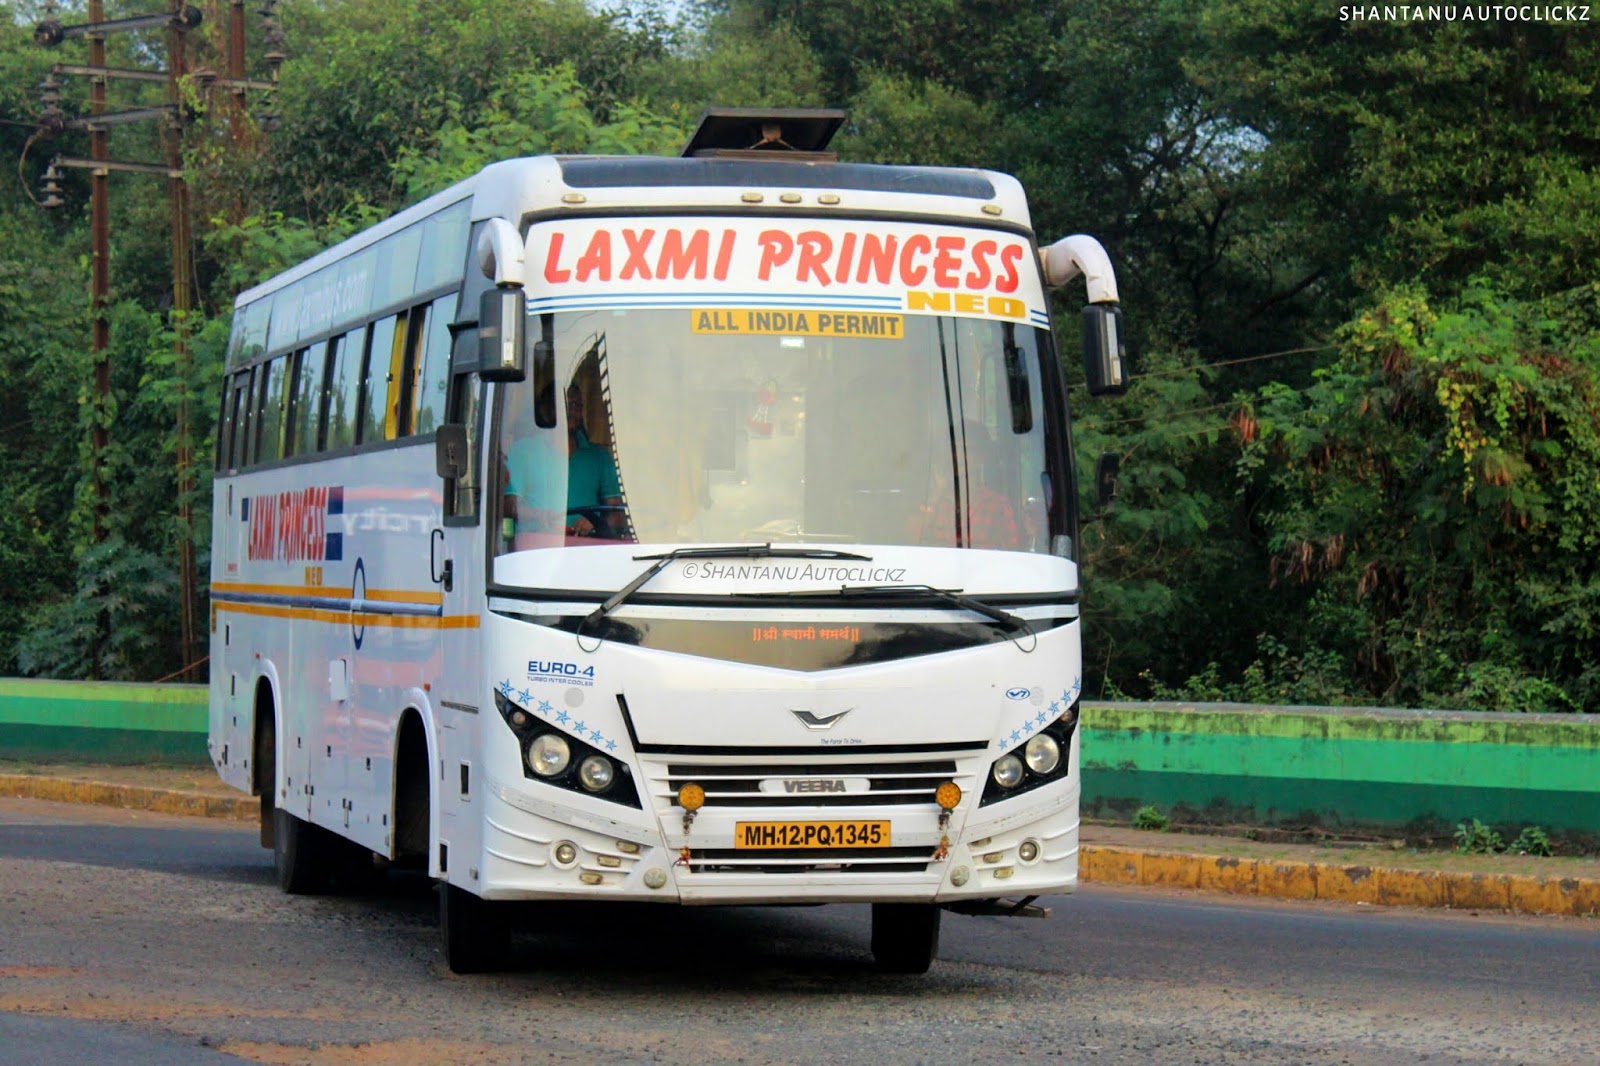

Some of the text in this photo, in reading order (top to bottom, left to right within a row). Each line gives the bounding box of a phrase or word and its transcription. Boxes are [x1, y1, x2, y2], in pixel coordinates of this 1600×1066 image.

[544, 229, 1023, 293] LAXMI PRINCESS
[907, 290, 1026, 314] NEO
[697, 311, 900, 336] ALL INDIA PERMIT
[248, 486, 327, 565] LAXMI PRINCESS
[527, 675, 548, 683] TURBO
[567, 679, 594, 687] COOLER
[783, 779, 847, 793] VEERA
